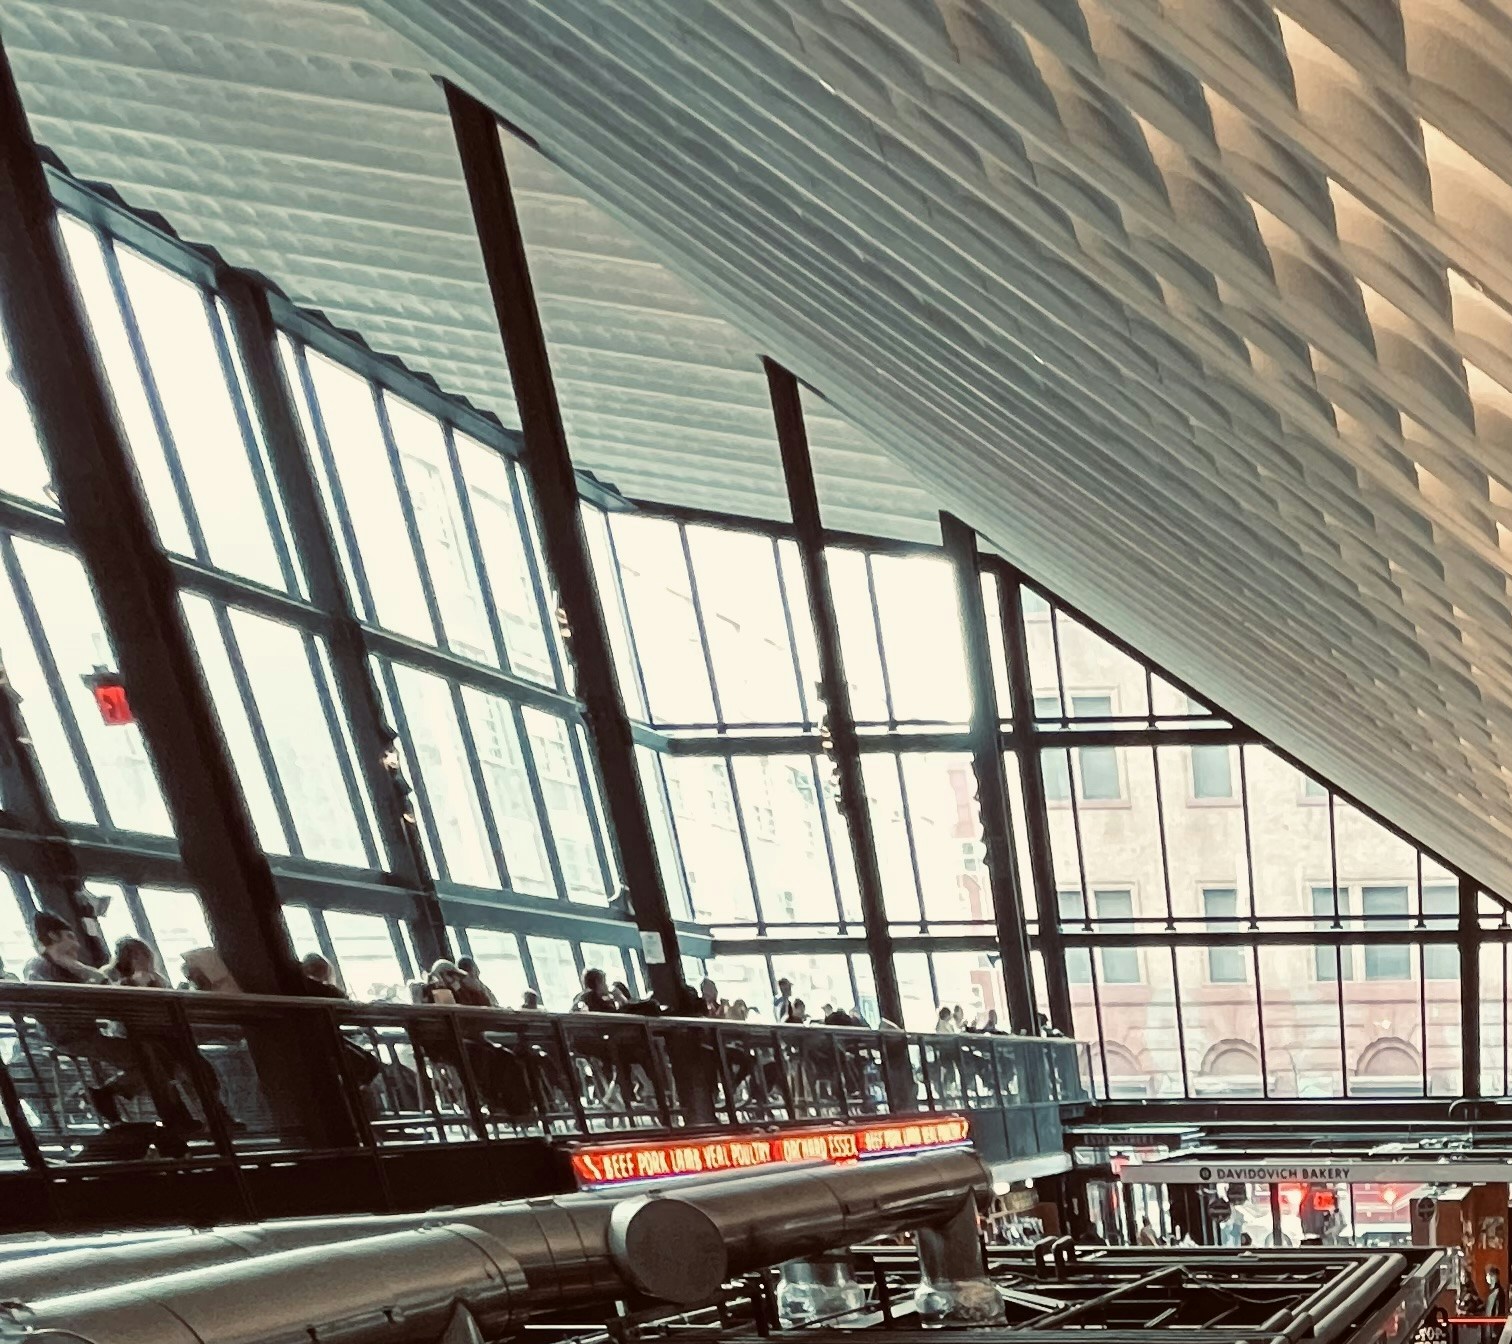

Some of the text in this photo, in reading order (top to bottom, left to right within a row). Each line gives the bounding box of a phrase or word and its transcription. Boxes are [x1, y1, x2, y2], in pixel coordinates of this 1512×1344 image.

[827, 1134, 859, 1158] ESSEX
[602, 1152, 635, 1180] BEEF
[637, 1151, 671, 1176] PORK
[669, 1148, 703, 1172] LAMB
[702, 1145, 731, 1170] VEAL
[730, 1141, 771, 1168] POULTRY
[1216, 1167, 1350, 1180] DAVIDOVICH BAKERY
[1419, 1327, 1443, 1341] TOP
